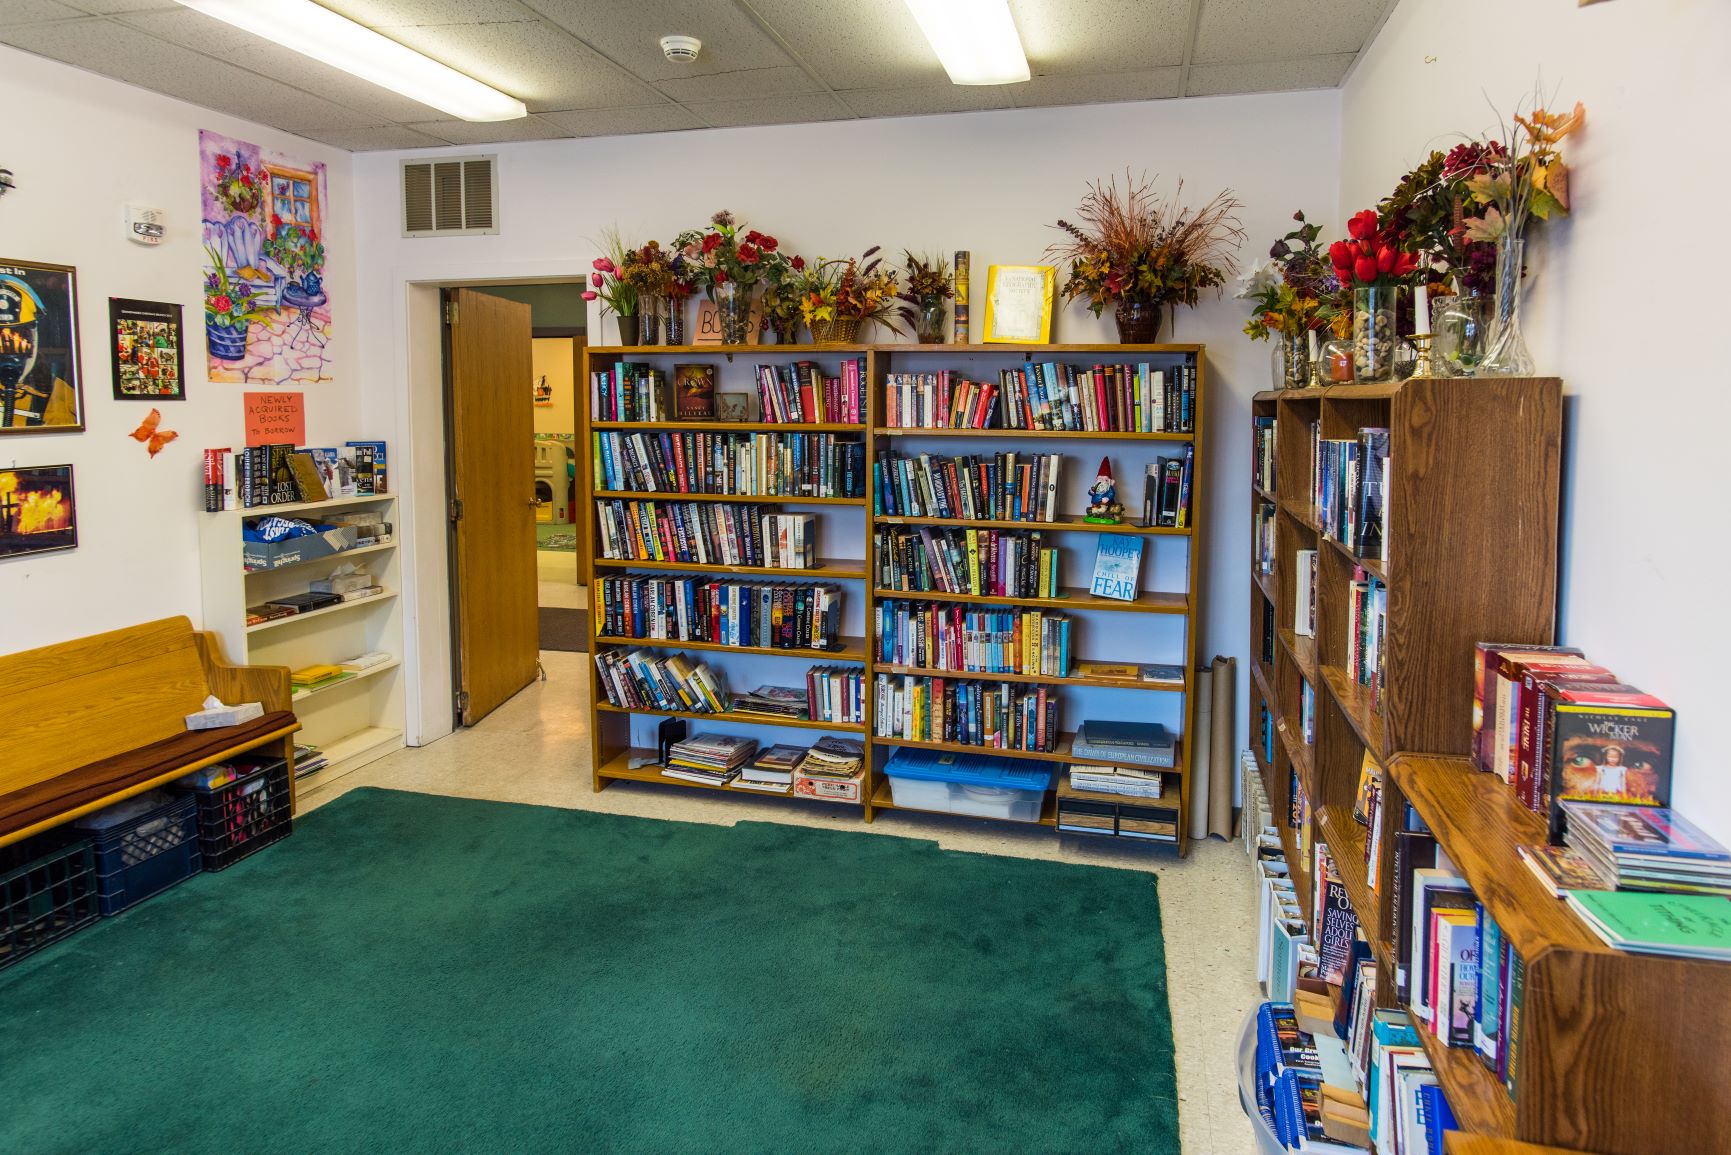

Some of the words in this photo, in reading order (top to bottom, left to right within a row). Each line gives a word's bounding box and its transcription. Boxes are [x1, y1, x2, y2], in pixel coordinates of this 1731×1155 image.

[260, 395, 293, 404] NEWLY
[249, 405, 298, 415] ACQUIRED
[259, 414, 290, 423] BOOKS
[277, 482, 293, 492] LOST
[271, 491, 295, 503] ORDER
[1113, 535, 1132, 545] KAY
[1101, 544, 1141, 560] HOOPER
[1094, 577, 1134, 599] FEAR
[1587, 723, 1639, 736] WICKER
[1610, 732, 1632, 741] MAN
[1108, 751, 1135, 760] EUROPEAN
[1328, 908, 1360, 924] SAVING
[1326, 916, 1355, 931] SELVES
[1324, 935, 1349, 949] GIRLS
[1289, 1046, 1303, 1054] Our
